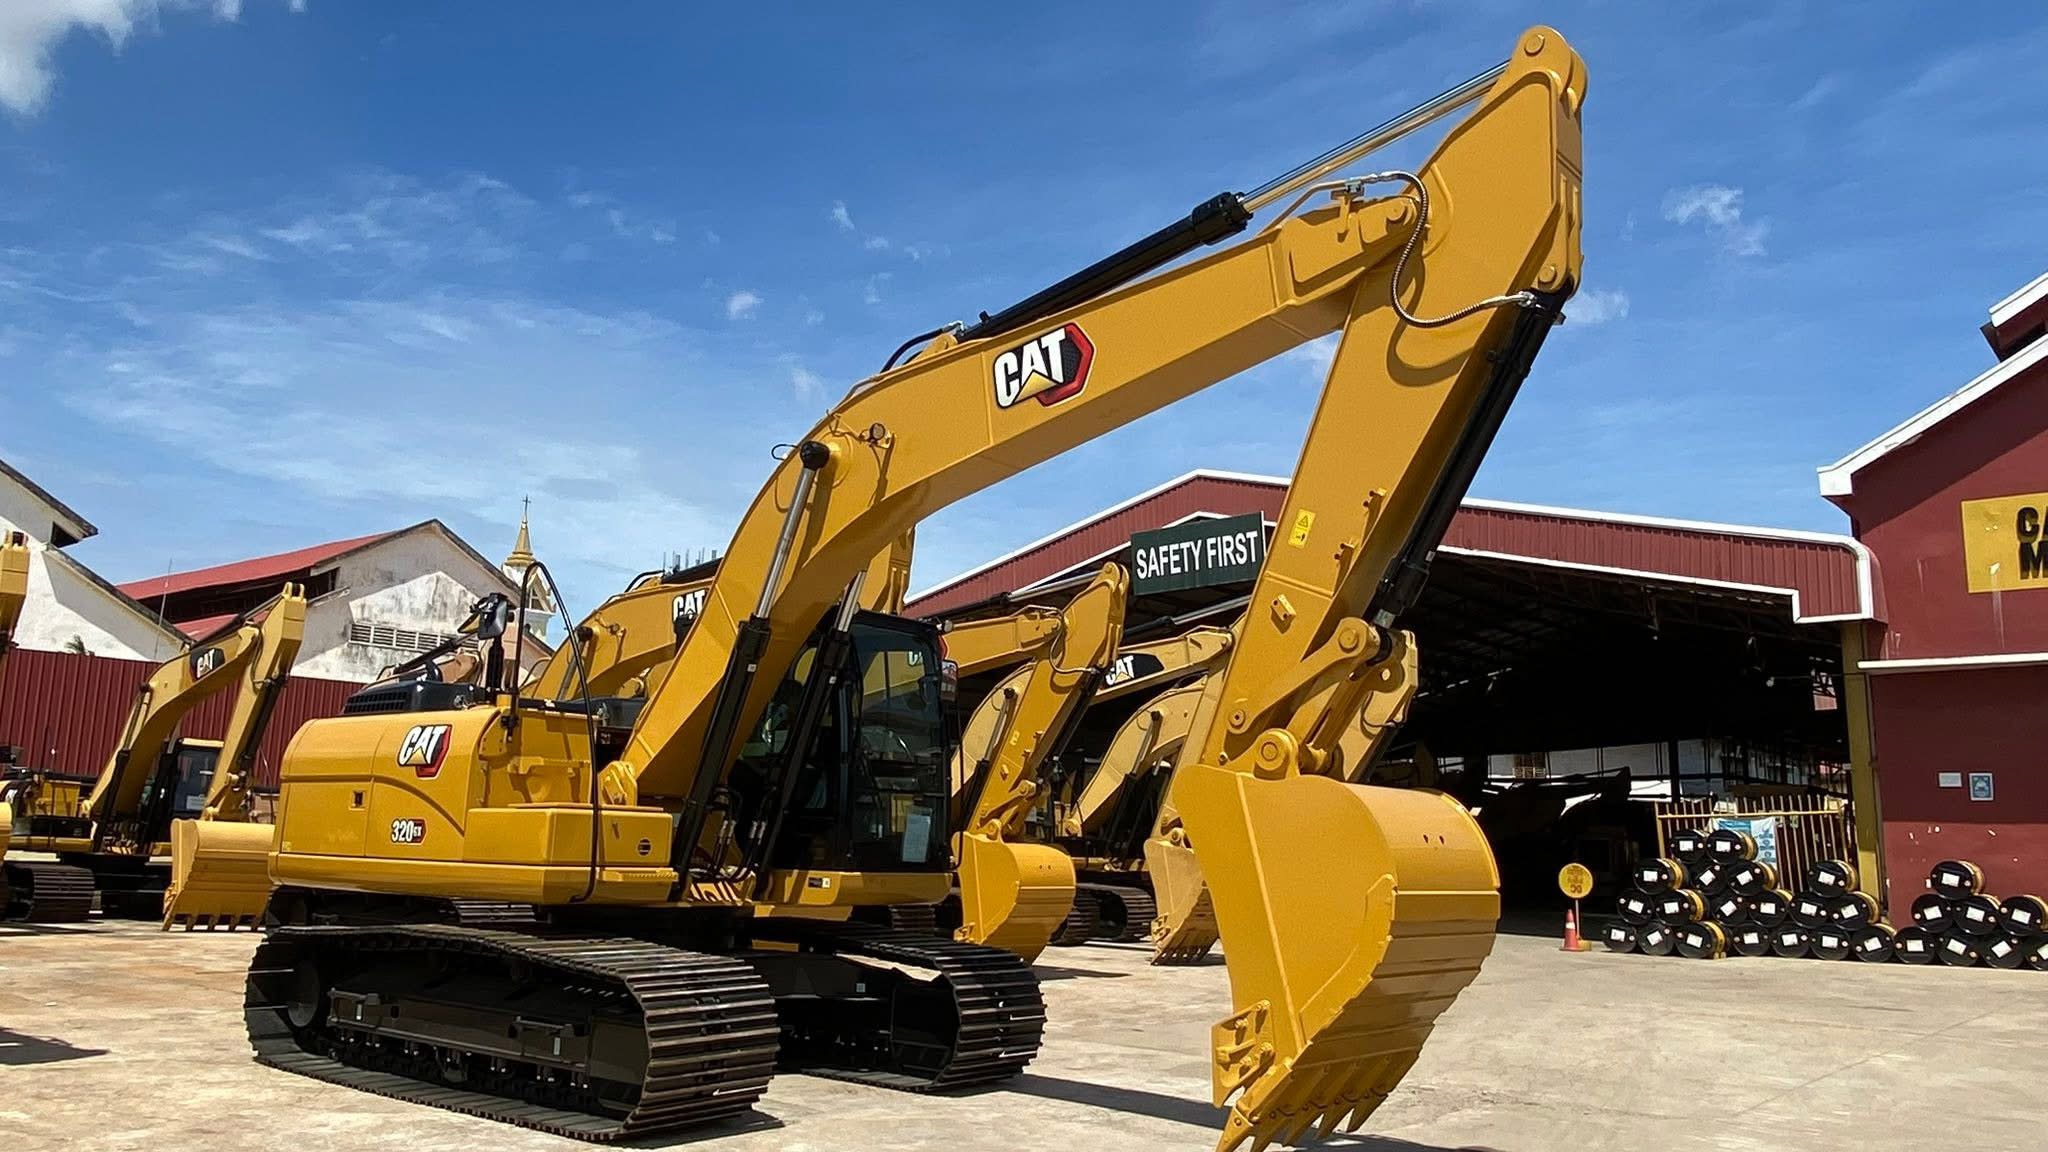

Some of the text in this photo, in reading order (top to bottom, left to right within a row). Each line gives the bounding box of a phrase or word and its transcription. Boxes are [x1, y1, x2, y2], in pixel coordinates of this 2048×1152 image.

[994, 327, 1066, 407] CAT
[1136, 530, 1258, 579] SAFETY FIRST
[672, 589, 706, 623] CAT
[196, 648, 215, 679] CAT
[398, 725, 449, 766] CAT
